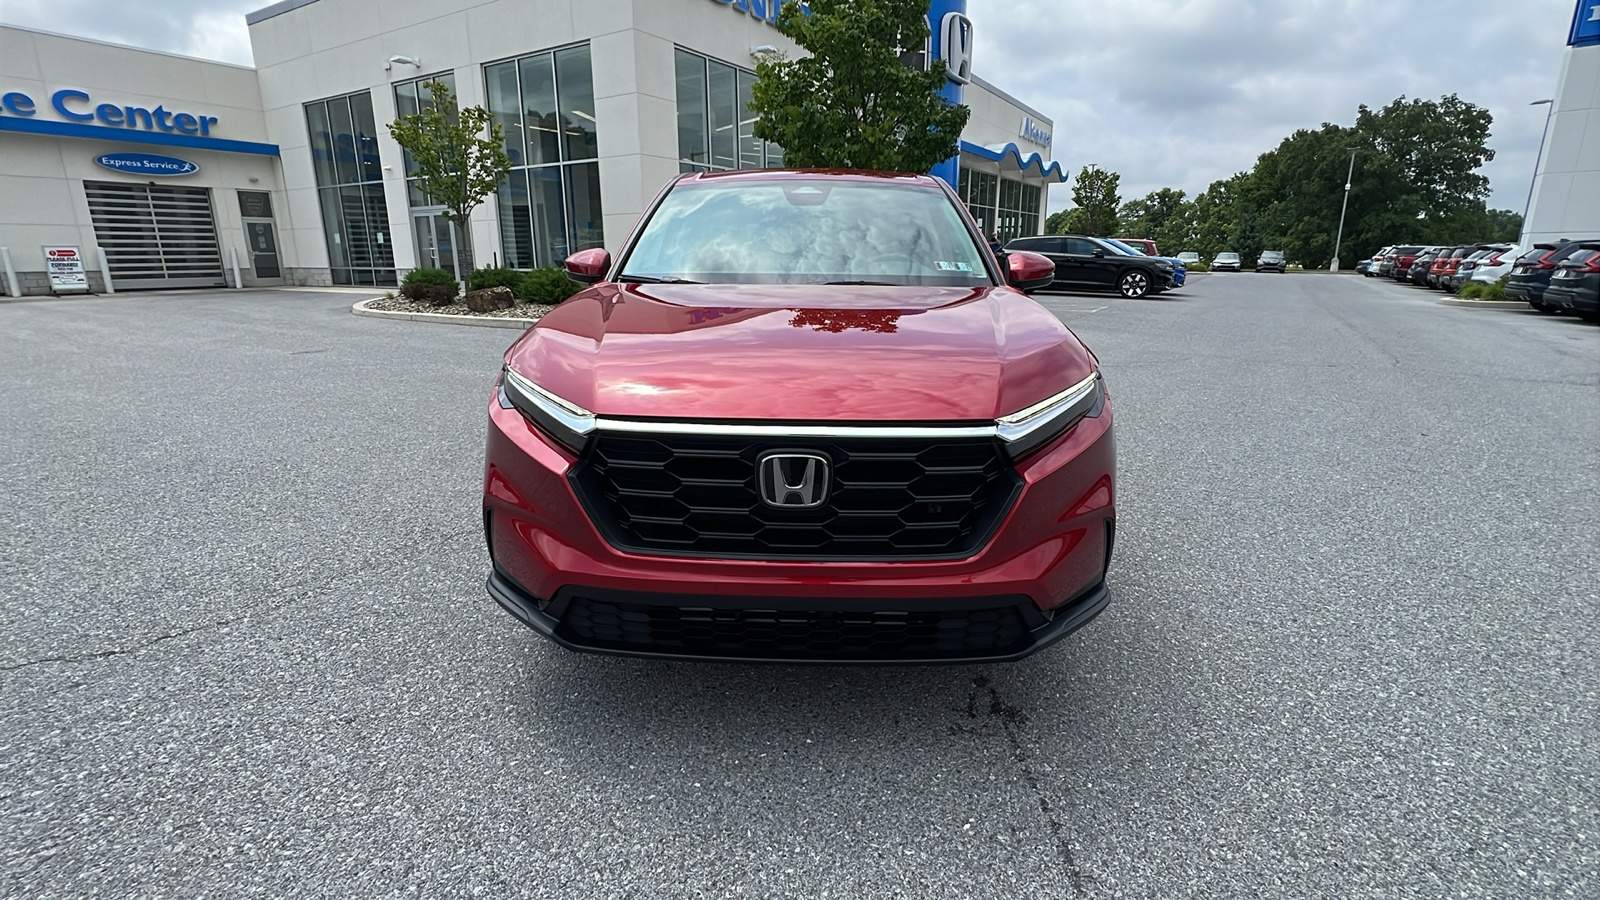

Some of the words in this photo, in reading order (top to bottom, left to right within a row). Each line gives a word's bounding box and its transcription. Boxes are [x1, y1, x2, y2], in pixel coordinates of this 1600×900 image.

[0, 92, 36, 116] e
[51, 89, 218, 135] Center
[101, 157, 141, 168] Express
[144, 160, 179, 170] Service
